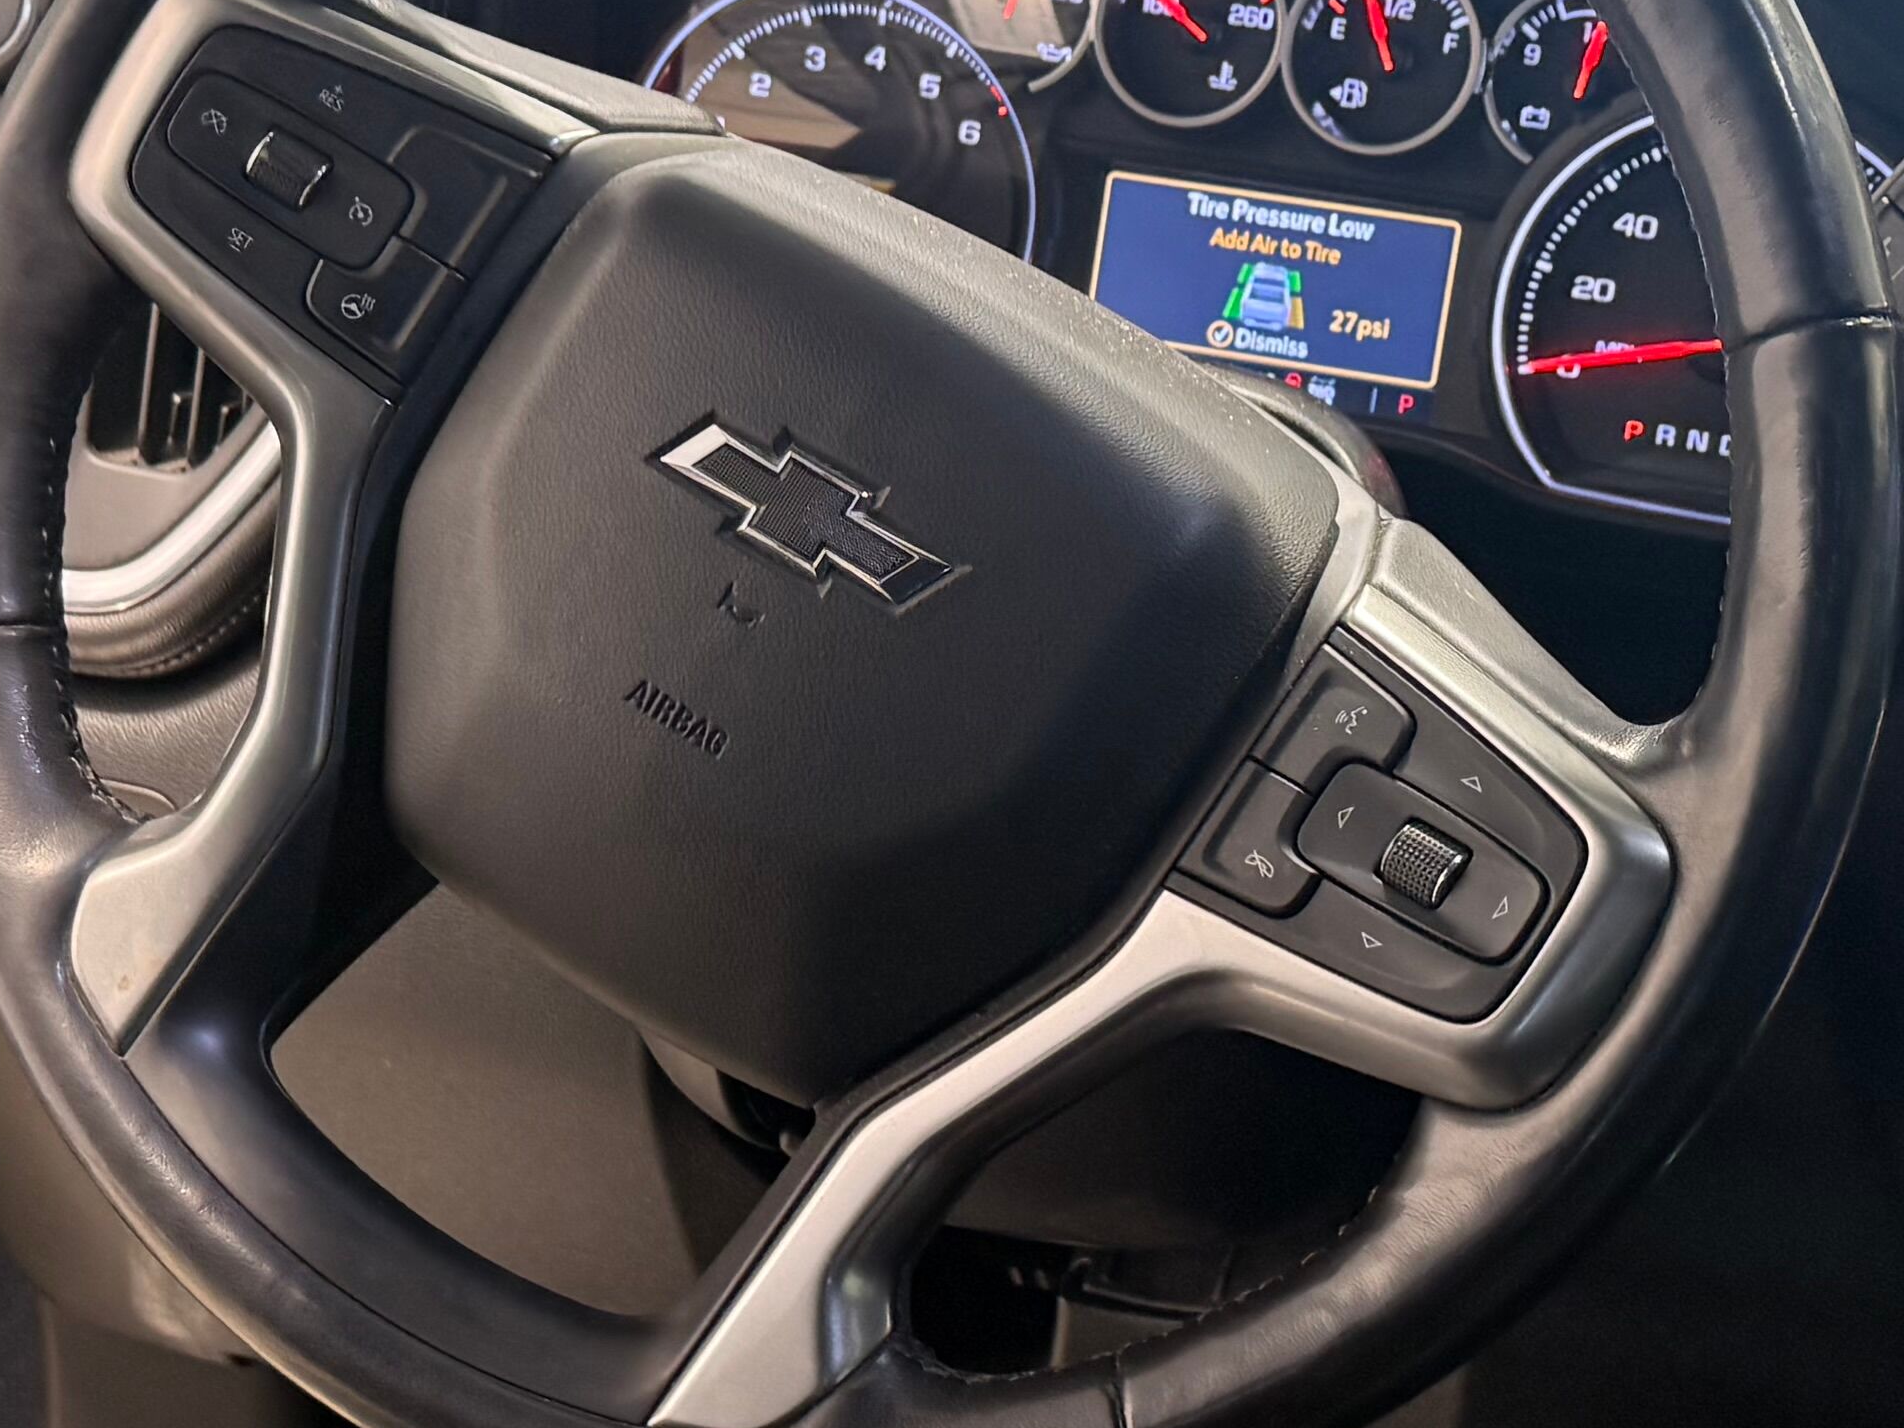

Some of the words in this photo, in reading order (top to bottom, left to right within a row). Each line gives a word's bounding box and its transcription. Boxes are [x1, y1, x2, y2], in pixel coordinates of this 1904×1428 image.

[1227, 3, 1275, 30] 260
[1330, 18, 1346, 40] E
[1442, 32, 1459, 54] F
[1523, 43, 1542, 66] 9
[804, 45, 827, 72] 3
[864, 45, 887, 72] 4
[749, 72, 772, 98] 2
[919, 72, 942, 100] 5
[319, 88, 344, 112] RES
[958, 119, 981, 146] 6
[1187, 190, 1230, 221] Tire
[1231, 198, 1326, 236] Pressure
[1327, 213, 1376, 242] Low
[1613, 212, 1659, 240] 40
[227, 226, 254, 250] SET
[1209, 226, 1249, 253] Add
[1250, 233, 1278, 257] Air
[1280, 239, 1302, 261] to
[1304, 241, 1341, 266] Tire
[1570, 275, 1616, 303] 20
[1328, 308, 1391, 342] 27psi
[1233, 326, 1309, 360] Dismiss
[1398, 393, 1415, 415] P
[1623, 420, 1645, 442] P
[1655, 424, 1677, 447] R
[1686, 429, 1709, 453] N
[623, 679, 731, 760] AIRBAG
